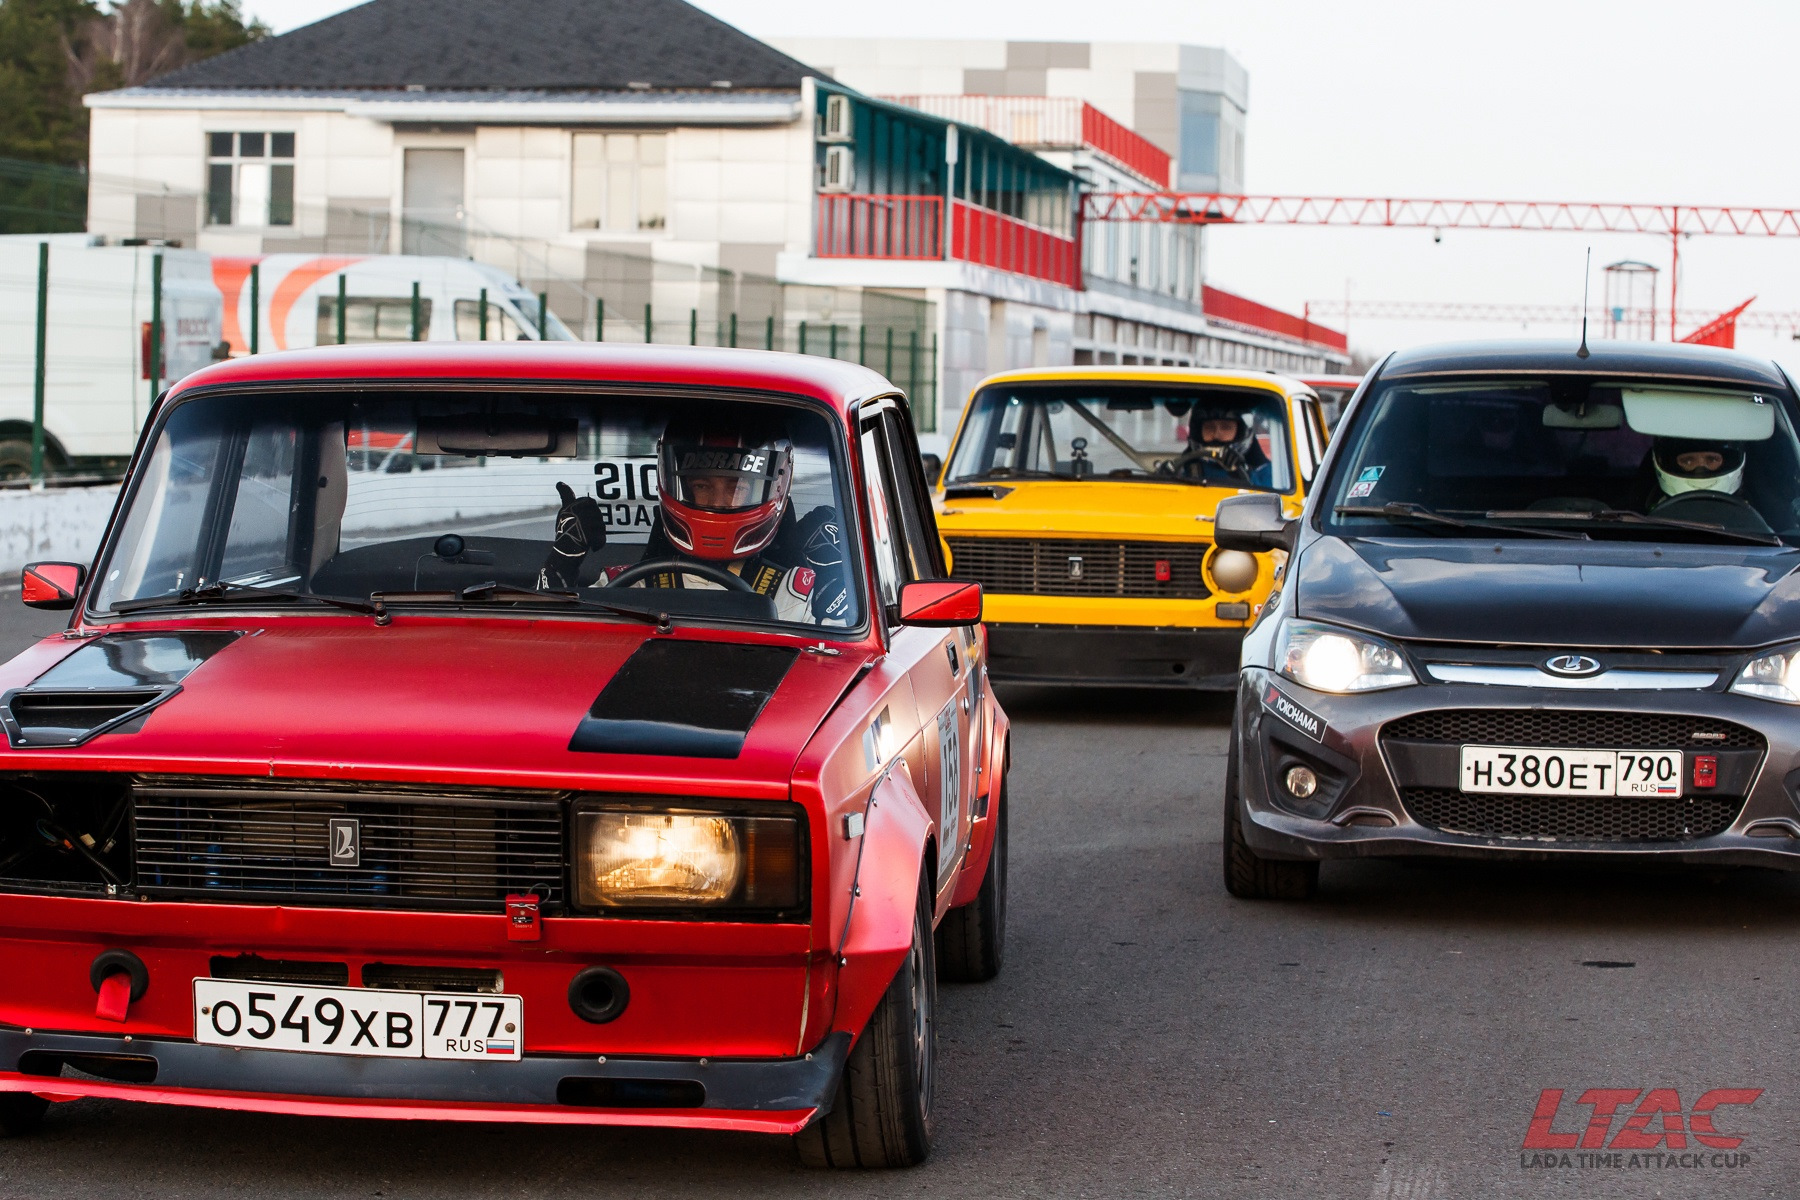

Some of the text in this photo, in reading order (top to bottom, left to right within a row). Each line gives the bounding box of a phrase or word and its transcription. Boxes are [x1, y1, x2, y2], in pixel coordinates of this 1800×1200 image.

[680, 452, 767, 474] DISRACE
[1276, 695, 1319, 735] YOKOHAMA
[944, 731, 959, 820] 158
[1620, 755, 1673, 782] 790
[1631, 783, 1657, 793] RUS
[427, 1000, 505, 1038] 777
[446, 1039, 484, 1053] RUS
